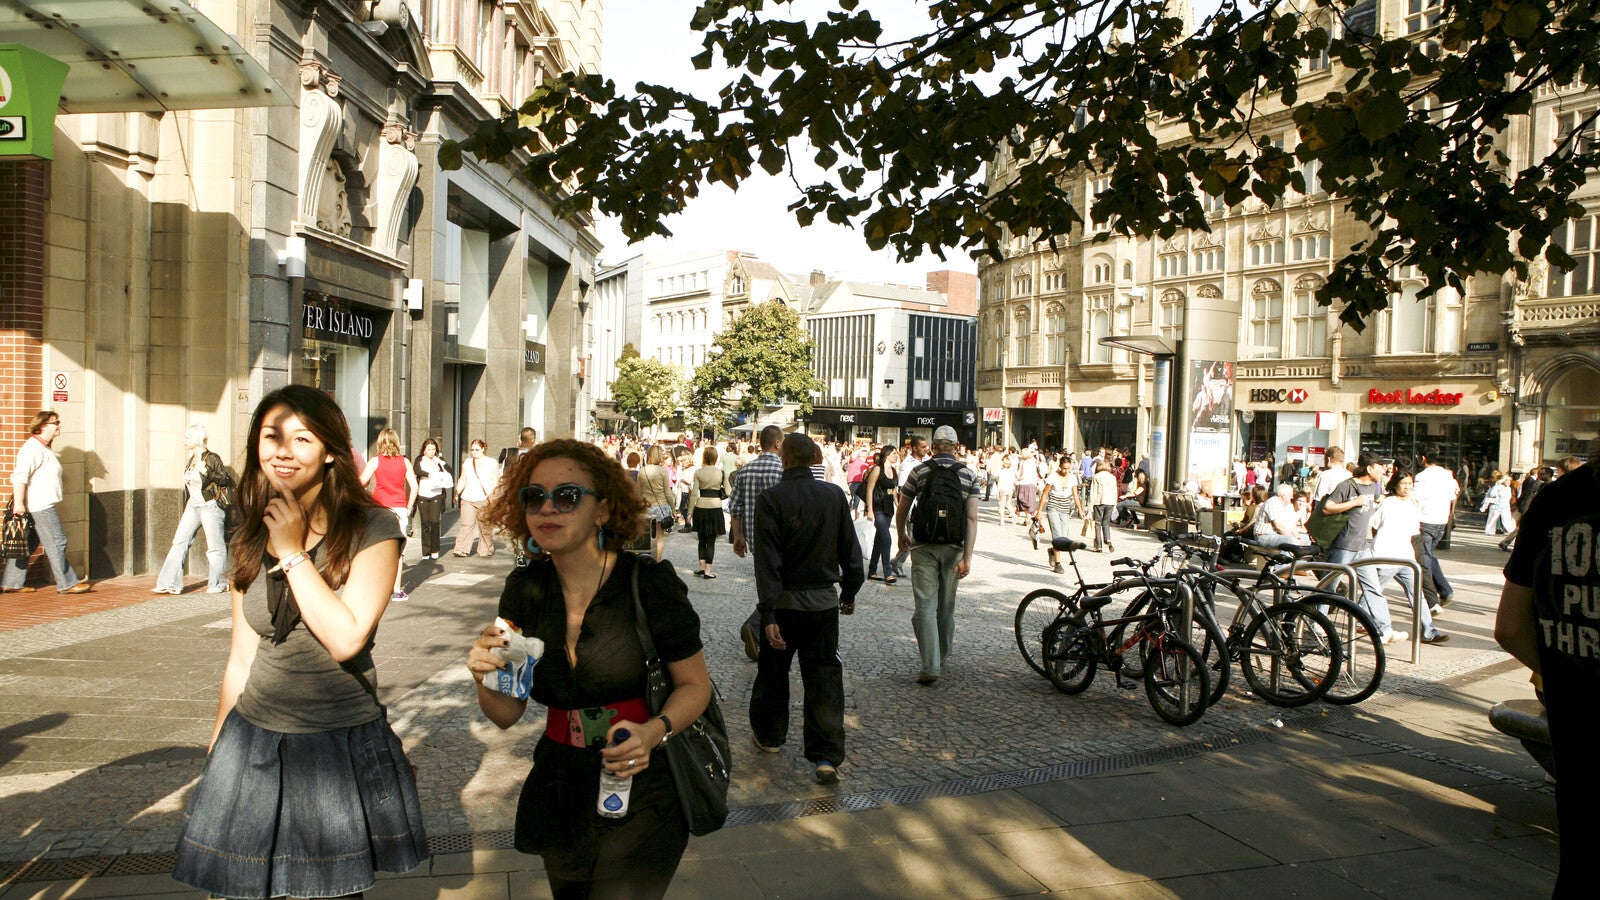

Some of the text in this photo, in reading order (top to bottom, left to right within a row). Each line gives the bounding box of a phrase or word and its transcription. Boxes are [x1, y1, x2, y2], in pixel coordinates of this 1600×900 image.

[329, 307, 373, 338] ISLAND
[1250, 388, 1287, 402] HSBC
[840, 414, 855, 423] next
[917, 417, 936, 425] next
[965, 412, 975, 424] 3
[1549, 522, 1600, 577] 10
